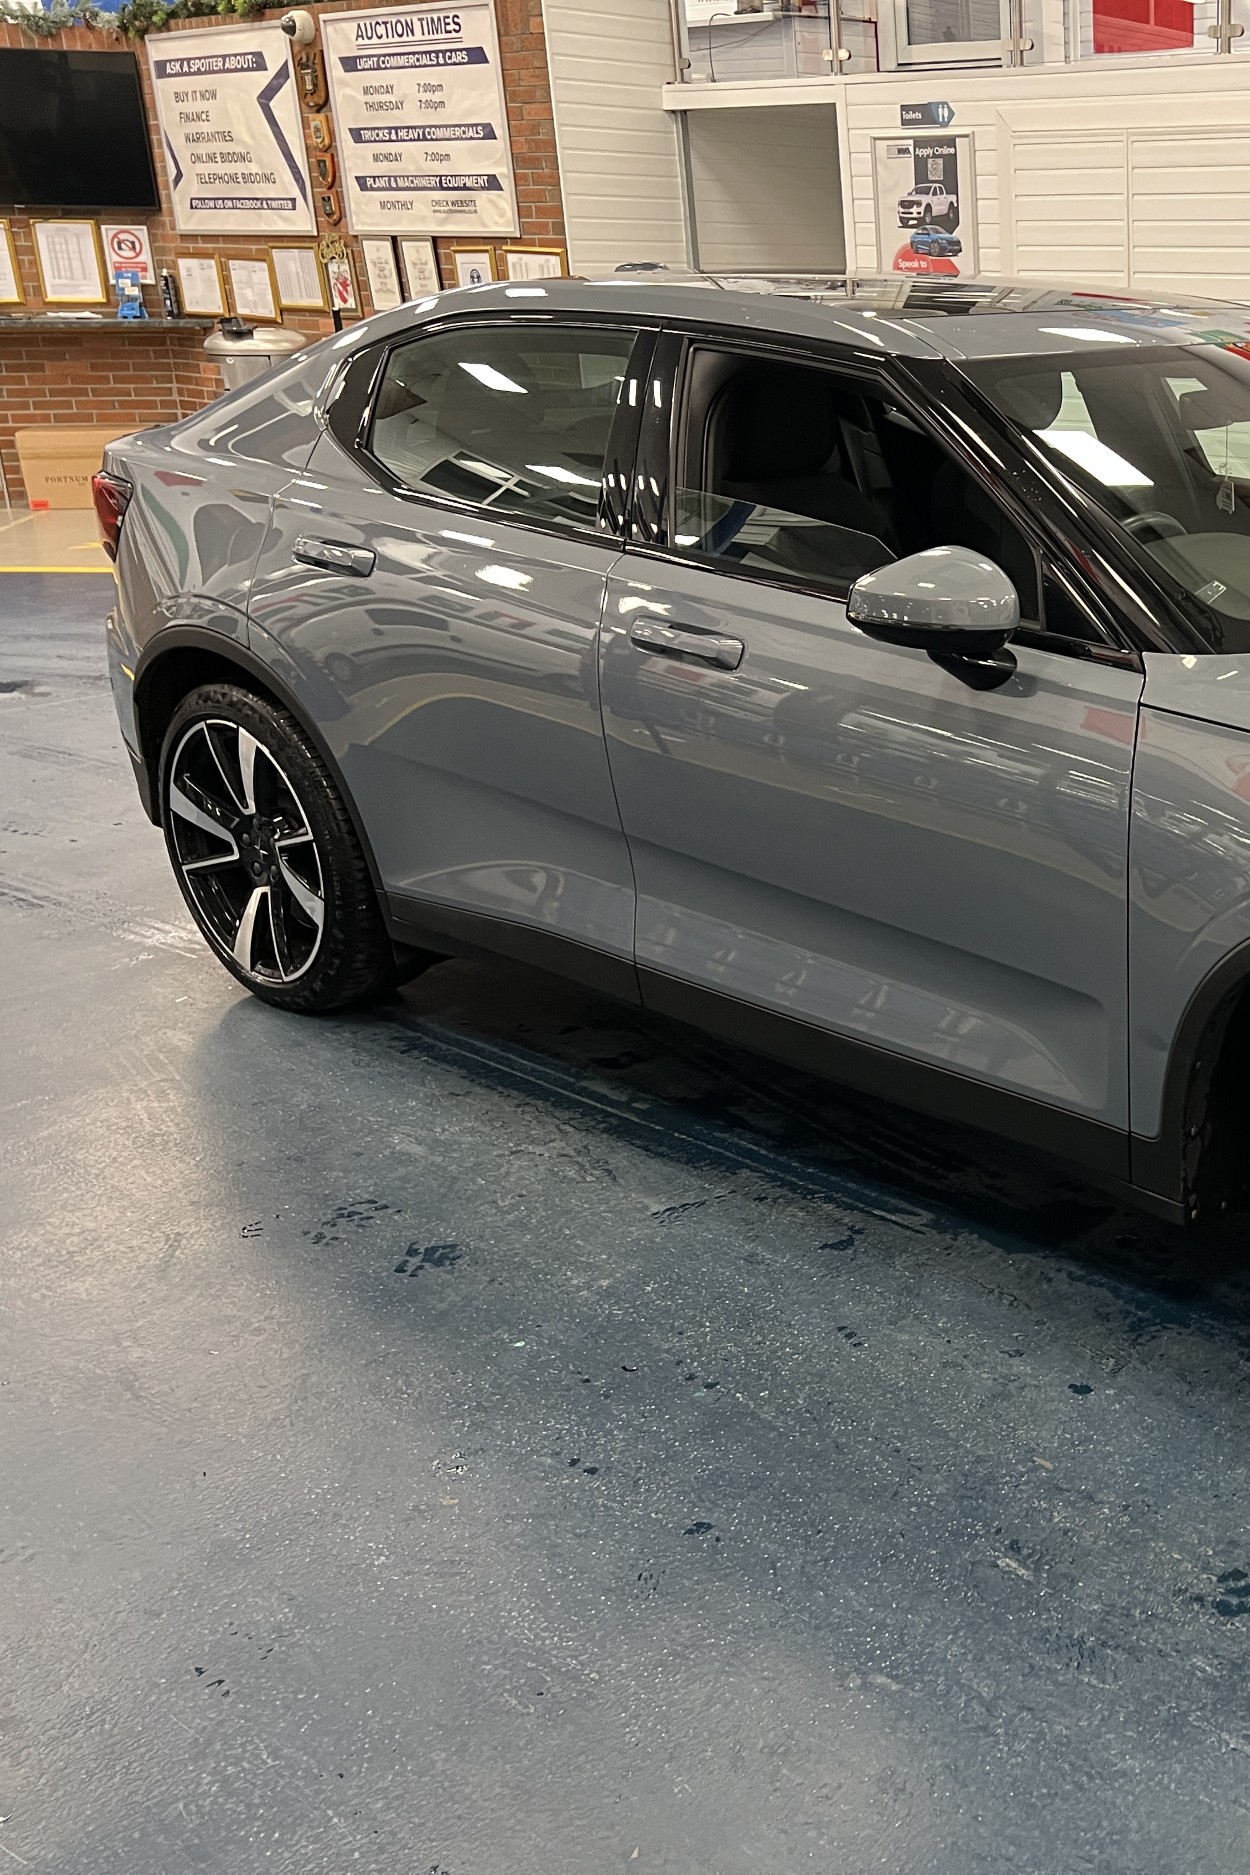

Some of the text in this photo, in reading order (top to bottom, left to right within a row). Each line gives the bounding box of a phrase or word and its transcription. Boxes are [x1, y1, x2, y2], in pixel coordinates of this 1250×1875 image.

[355, 14, 462, 41] AUCTION TIMES
[166, 55, 257, 75] ASK A SPOTTER ABOUT:
[356, 51, 468, 69] LIGHT COMMERCIALS & CARS
[174, 89, 217, 103] BUY IT NOW
[362, 83, 444, 96] MONDAY 7:00pm
[364, 99, 446, 112] THURSDAY 7:00pm
[179, 111, 210, 124] FINANCE
[902, 111, 922, 120] Toilets
[184, 131, 234, 144] WARRANTIES
[360, 126, 484, 141] TRUCKS & HEAVY COMMERCIALS
[190, 151, 253, 164] ONLINE BIDDING
[373, 152, 451, 164] MONDAY 7:00pm
[915, 145, 956, 158] Apply Online
[196, 172, 276, 185] TELEPHONE BIDDING
[366, 176, 488, 188] PLANT & MACHINERY EQUIPMENT
[192, 200, 214, 209] FOLLOW
[215, 200, 223, 209] US
[224, 200, 233, 209] ON
[234, 200, 262, 209] FACEBOOK
[268, 200, 293, 209] TWITTER
[379, 200, 414, 211] MONTHLY
[431, 199, 477, 208] CHECK WEBSITE
[898, 259, 928, 270] Speak to
